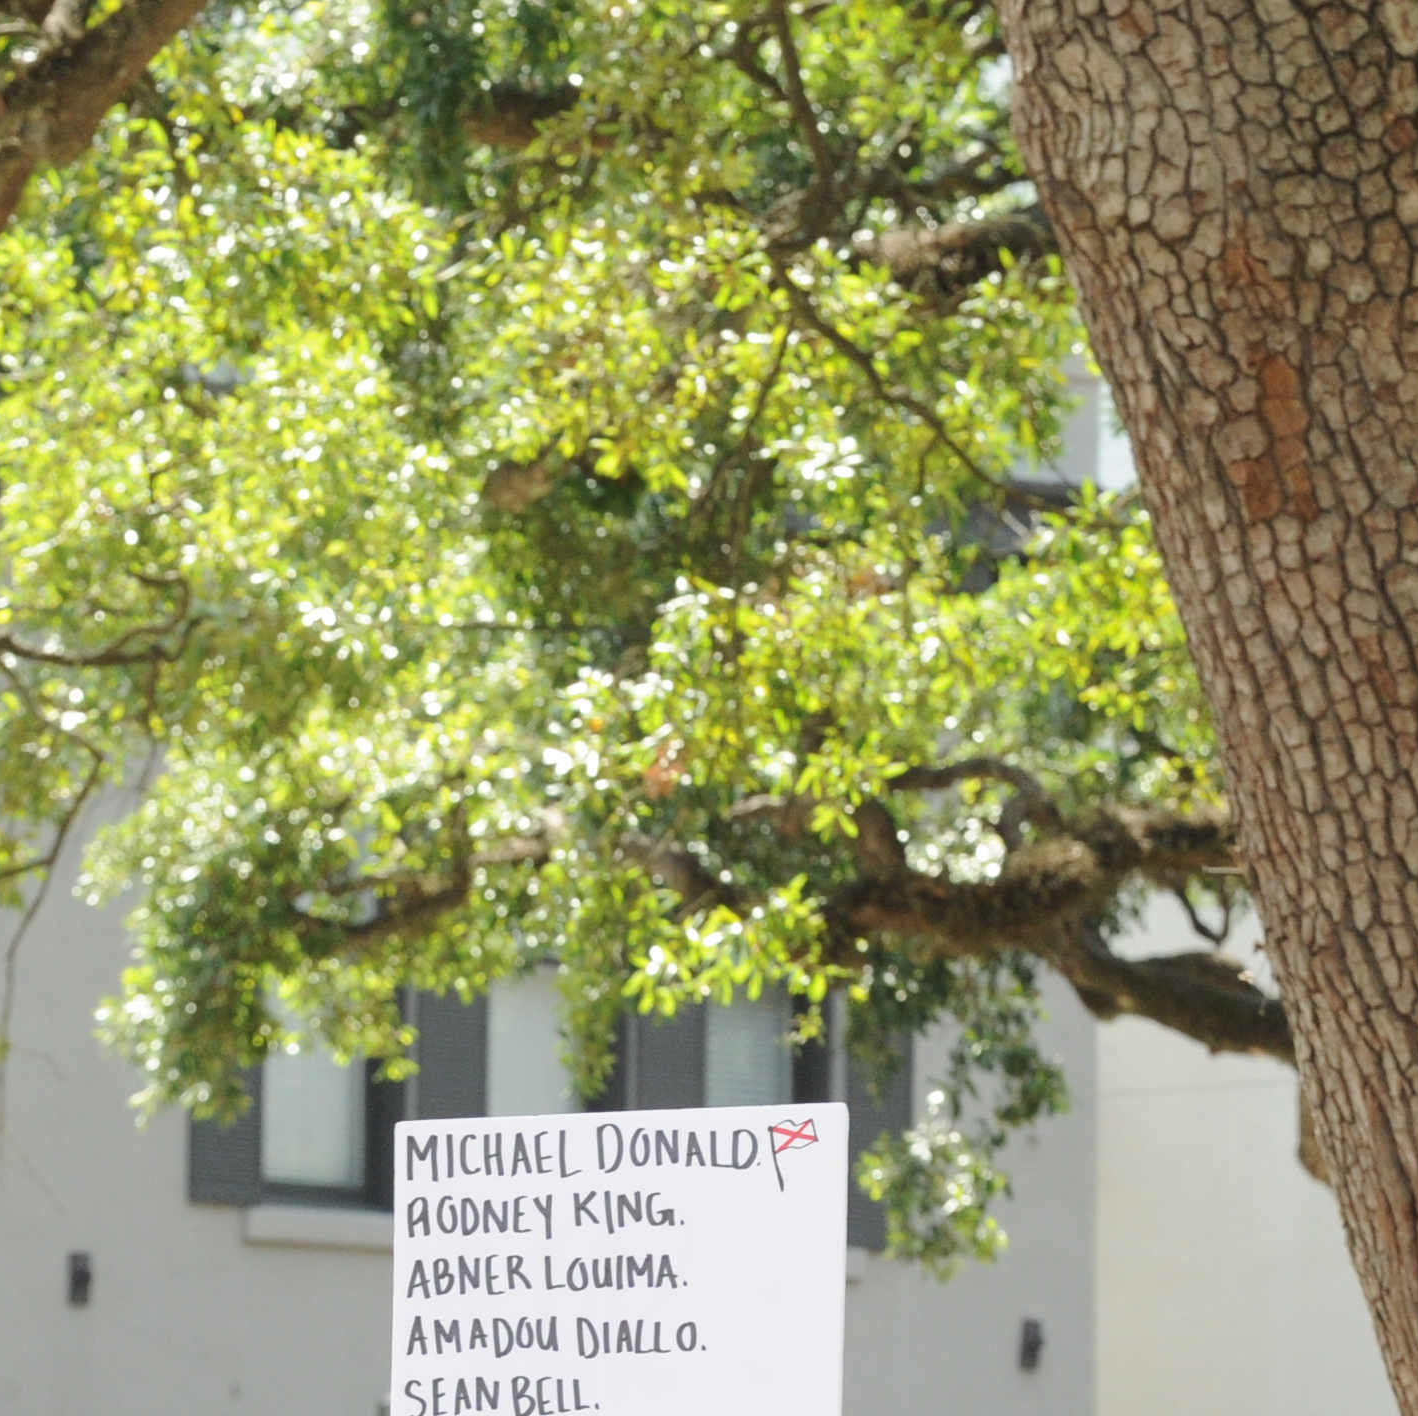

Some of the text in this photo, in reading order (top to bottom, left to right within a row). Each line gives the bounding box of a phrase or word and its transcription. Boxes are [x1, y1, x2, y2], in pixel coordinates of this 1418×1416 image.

[407, 1122, 761, 1182] MICHAEL DONALD.
[407, 1190, 685, 1240] RODNEY KING.
[407, 1254, 687, 1299] ABNER LOUIMA.
[406, 1316, 706, 1359] AMADOU DIALLO.
